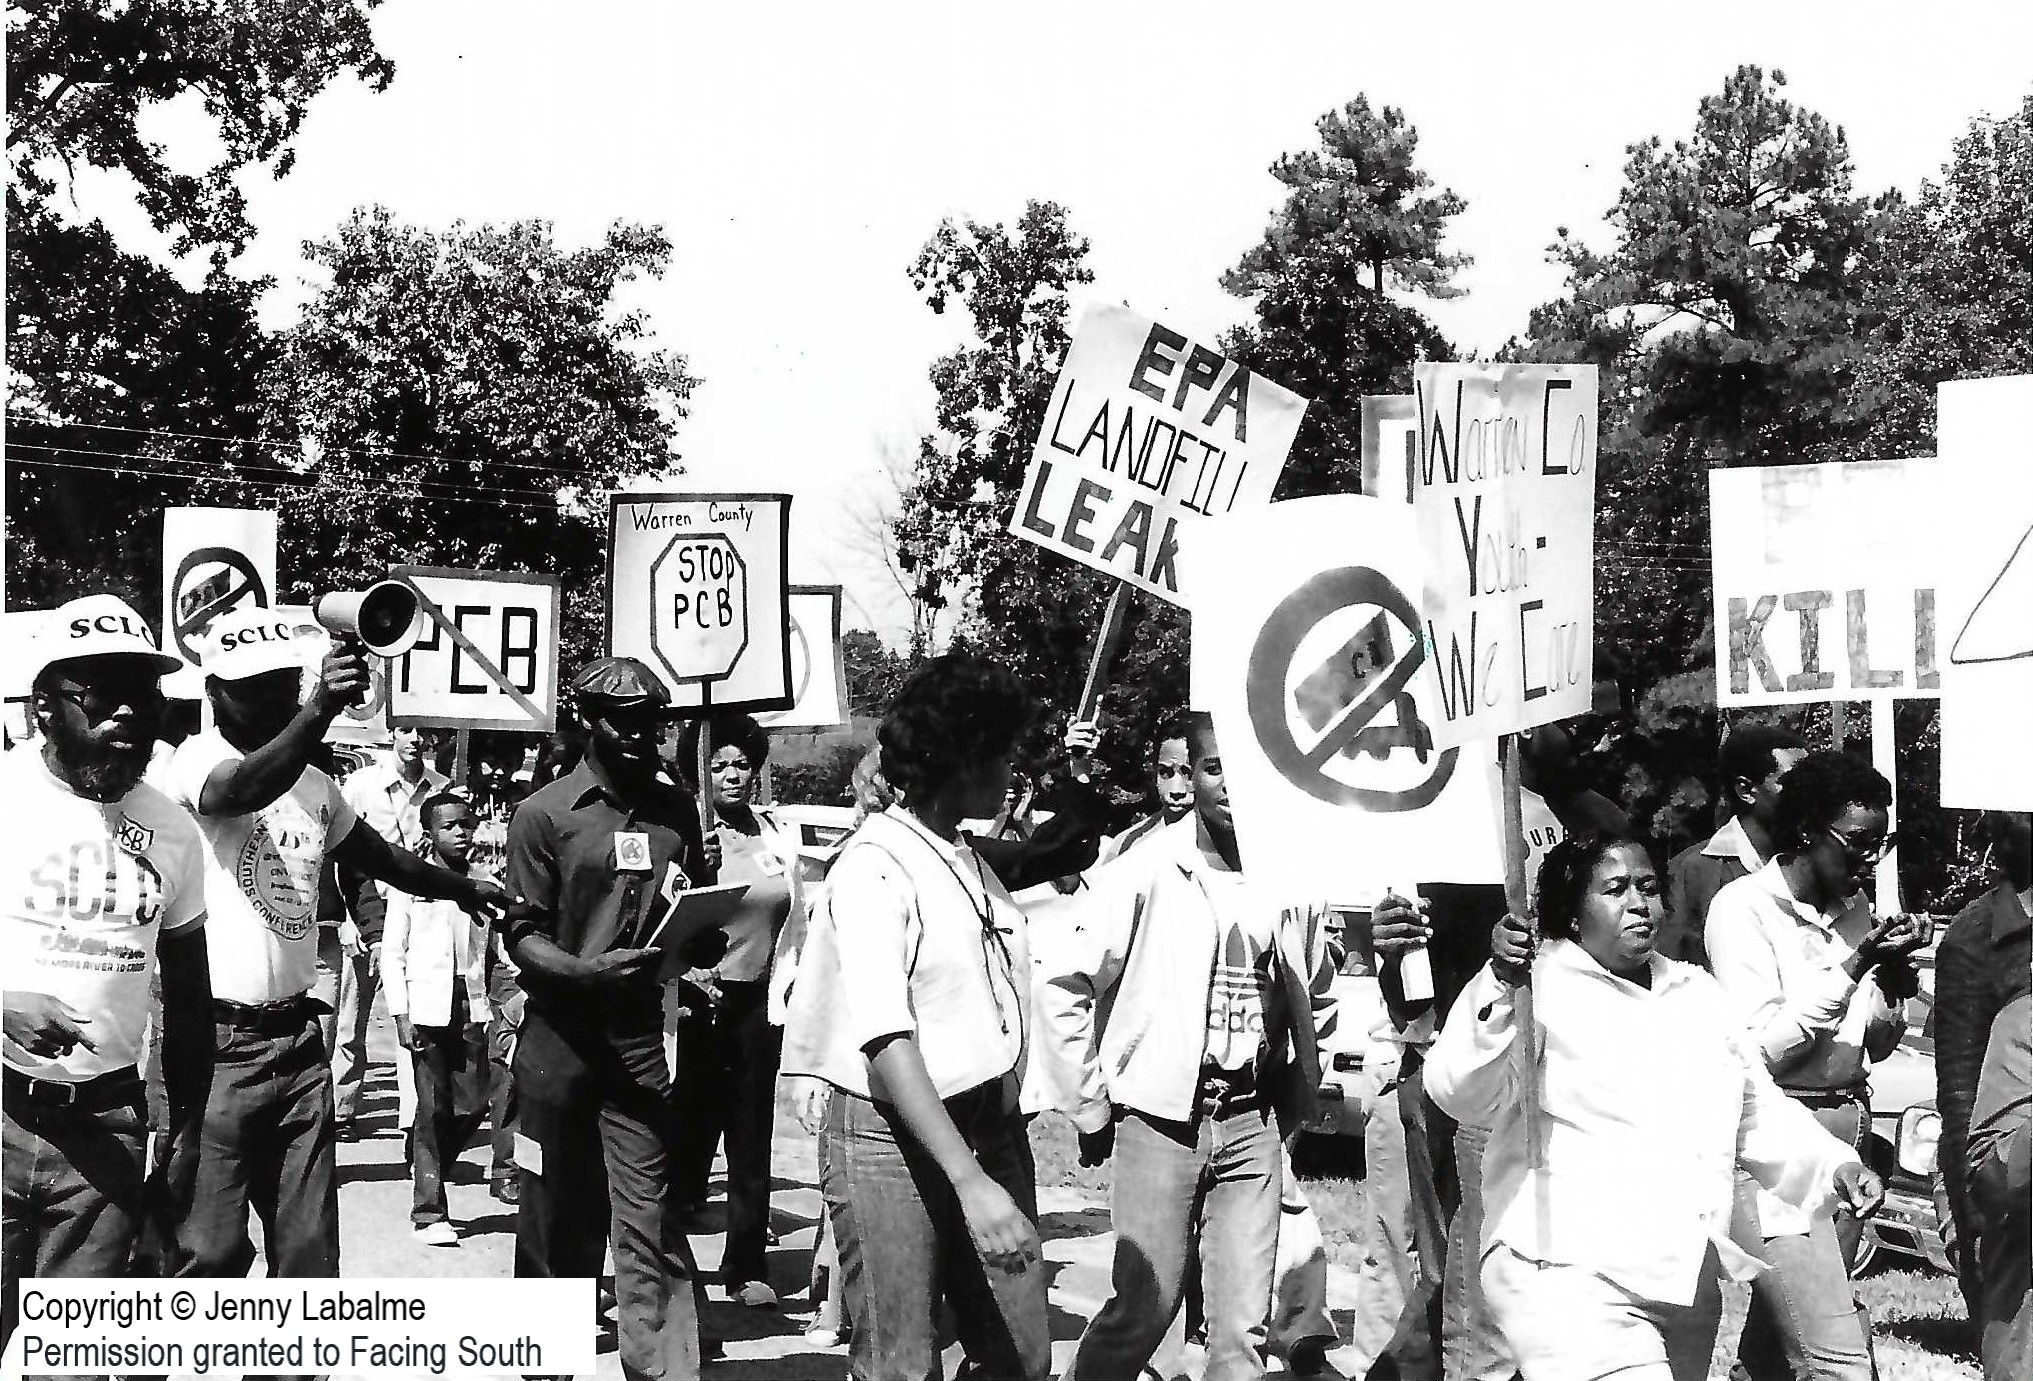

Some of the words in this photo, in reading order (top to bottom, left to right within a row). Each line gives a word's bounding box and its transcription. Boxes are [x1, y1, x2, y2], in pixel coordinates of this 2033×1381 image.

[1129, 322, 1251, 444] EPA
[631, 502, 692, 531] Warren
[708, 501, 753, 532] County
[220, 622, 290, 652] SCLC
[673, 587, 734, 630] PCB
[400, 604, 538, 695] PCB
[23, 839, 164, 927] SCLC
